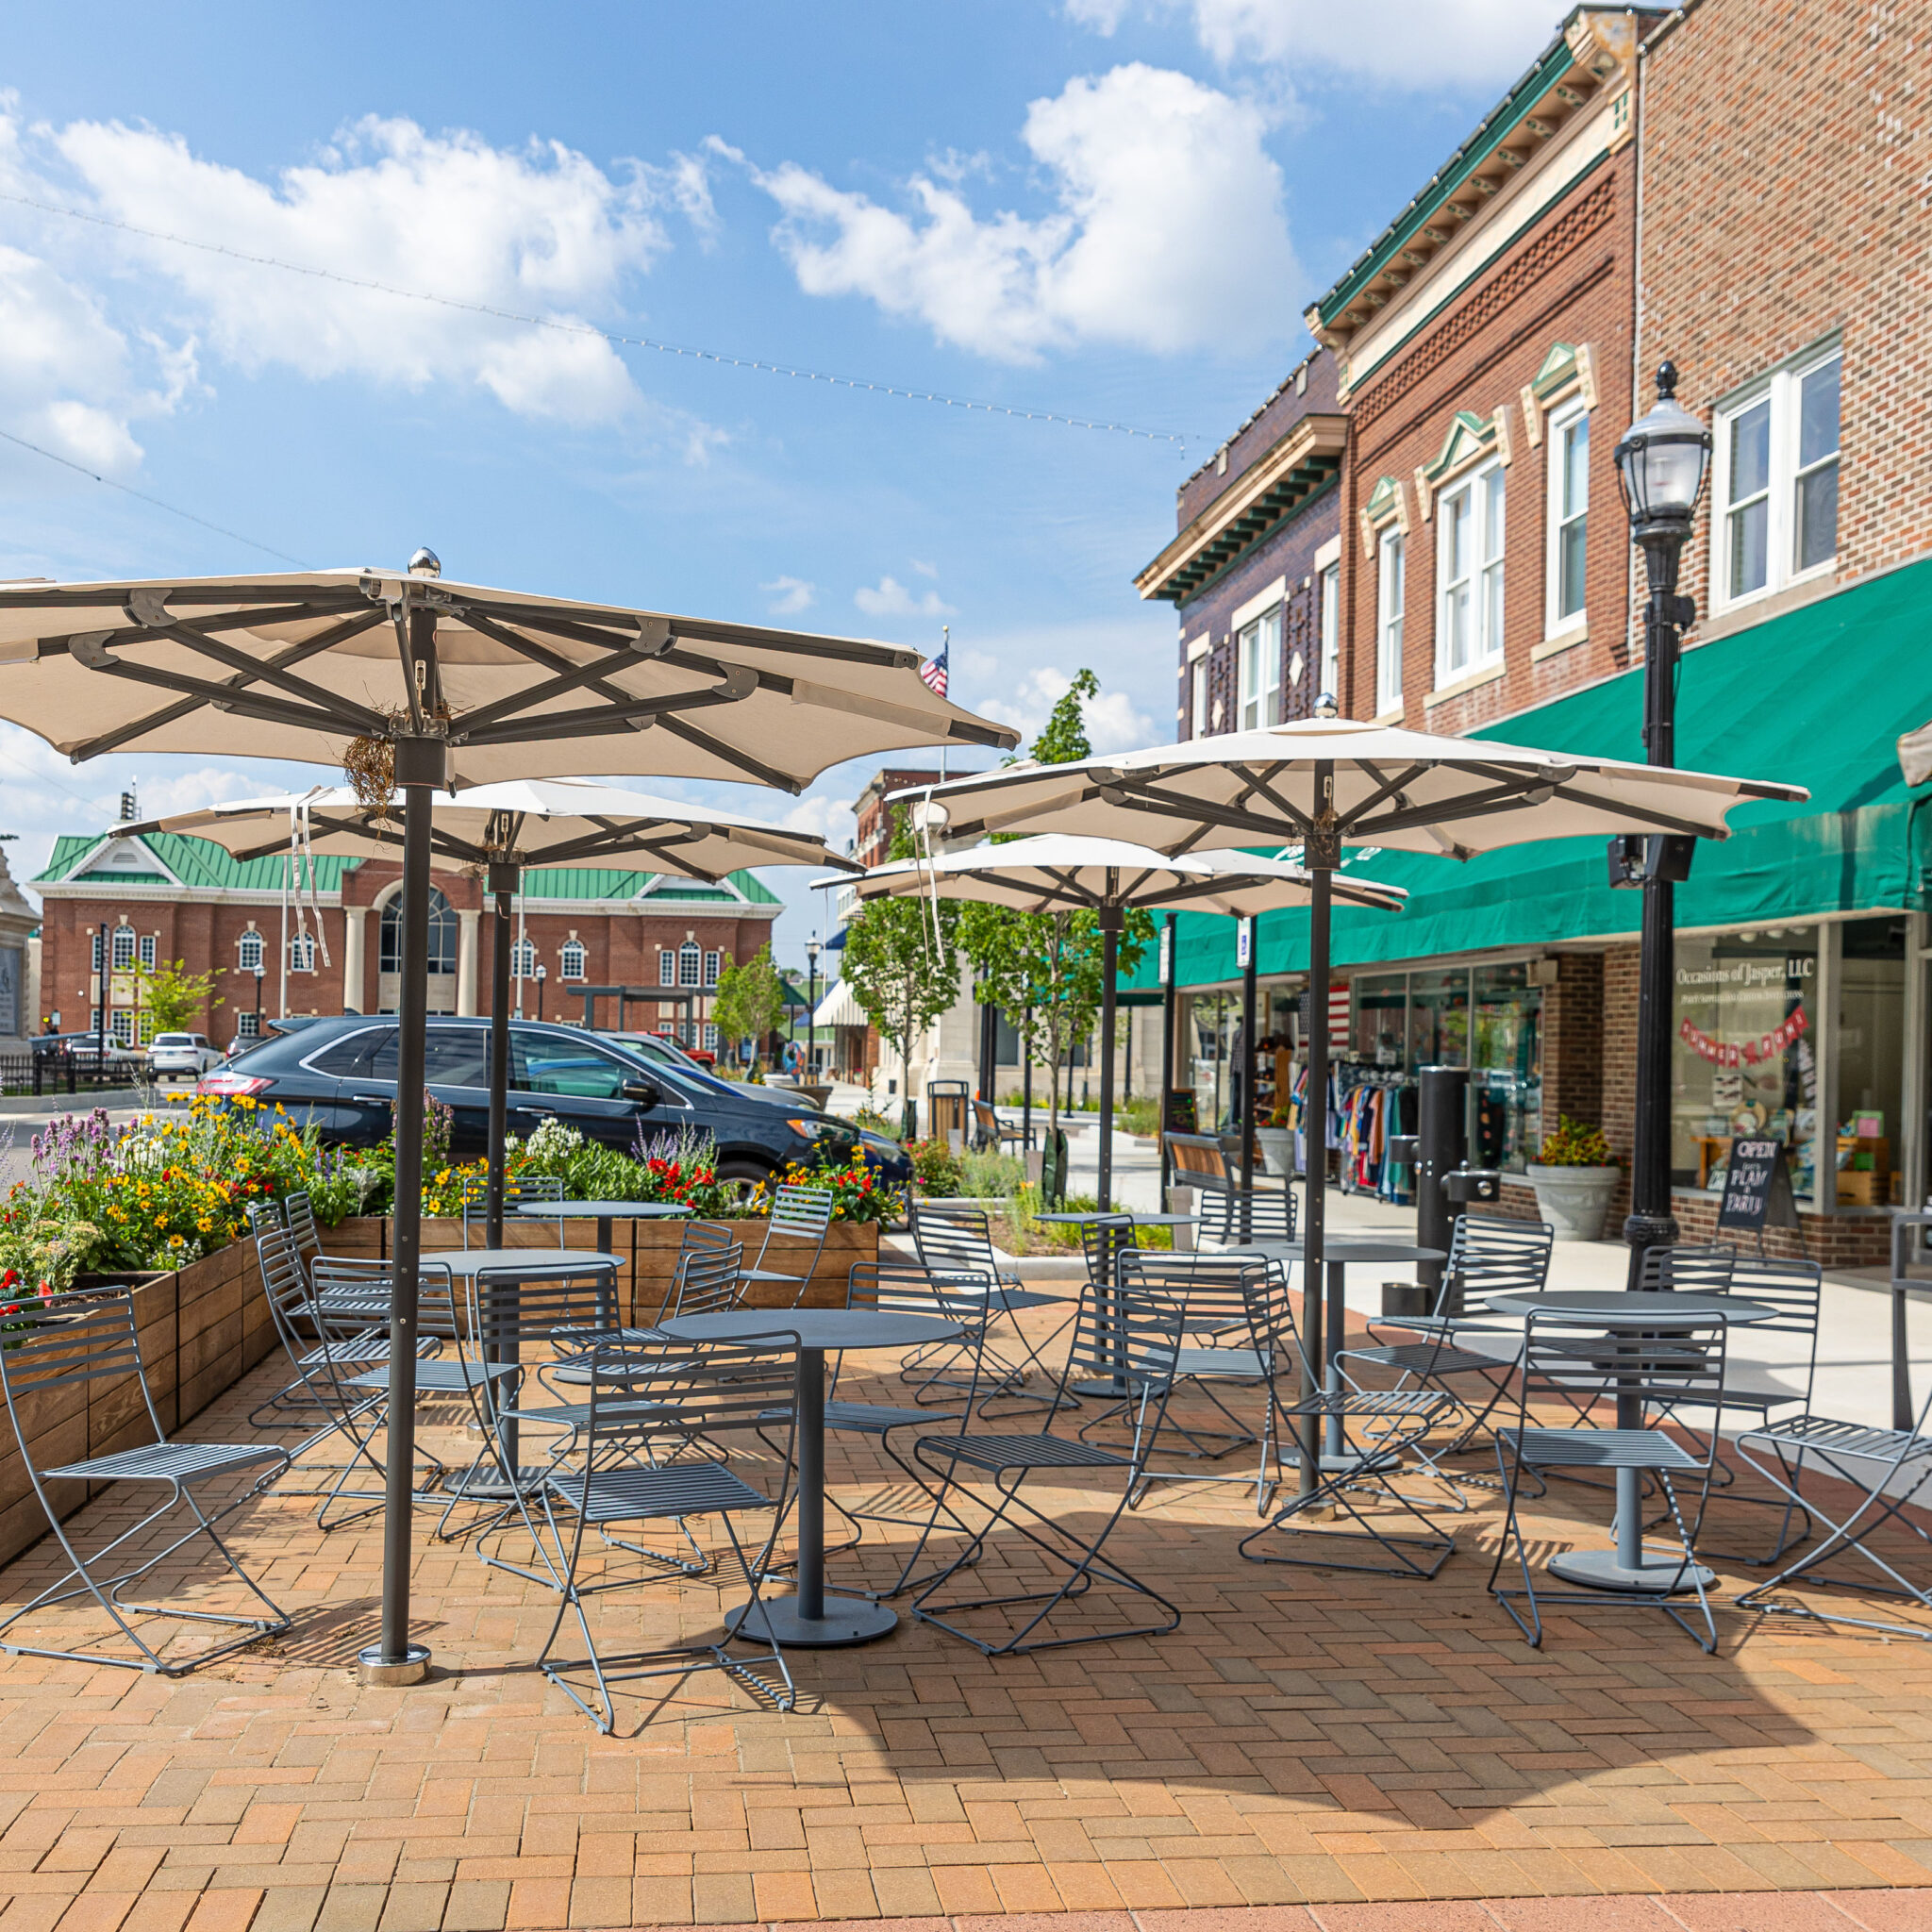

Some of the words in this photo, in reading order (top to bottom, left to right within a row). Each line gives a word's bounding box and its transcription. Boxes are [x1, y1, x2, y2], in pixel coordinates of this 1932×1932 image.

[1675, 966, 1729, 985] Occasions
[1731, 963, 1745, 981] of
[1788, 958, 1814, 977] LLC
[1737, 1141, 1777, 1158] OPEN
